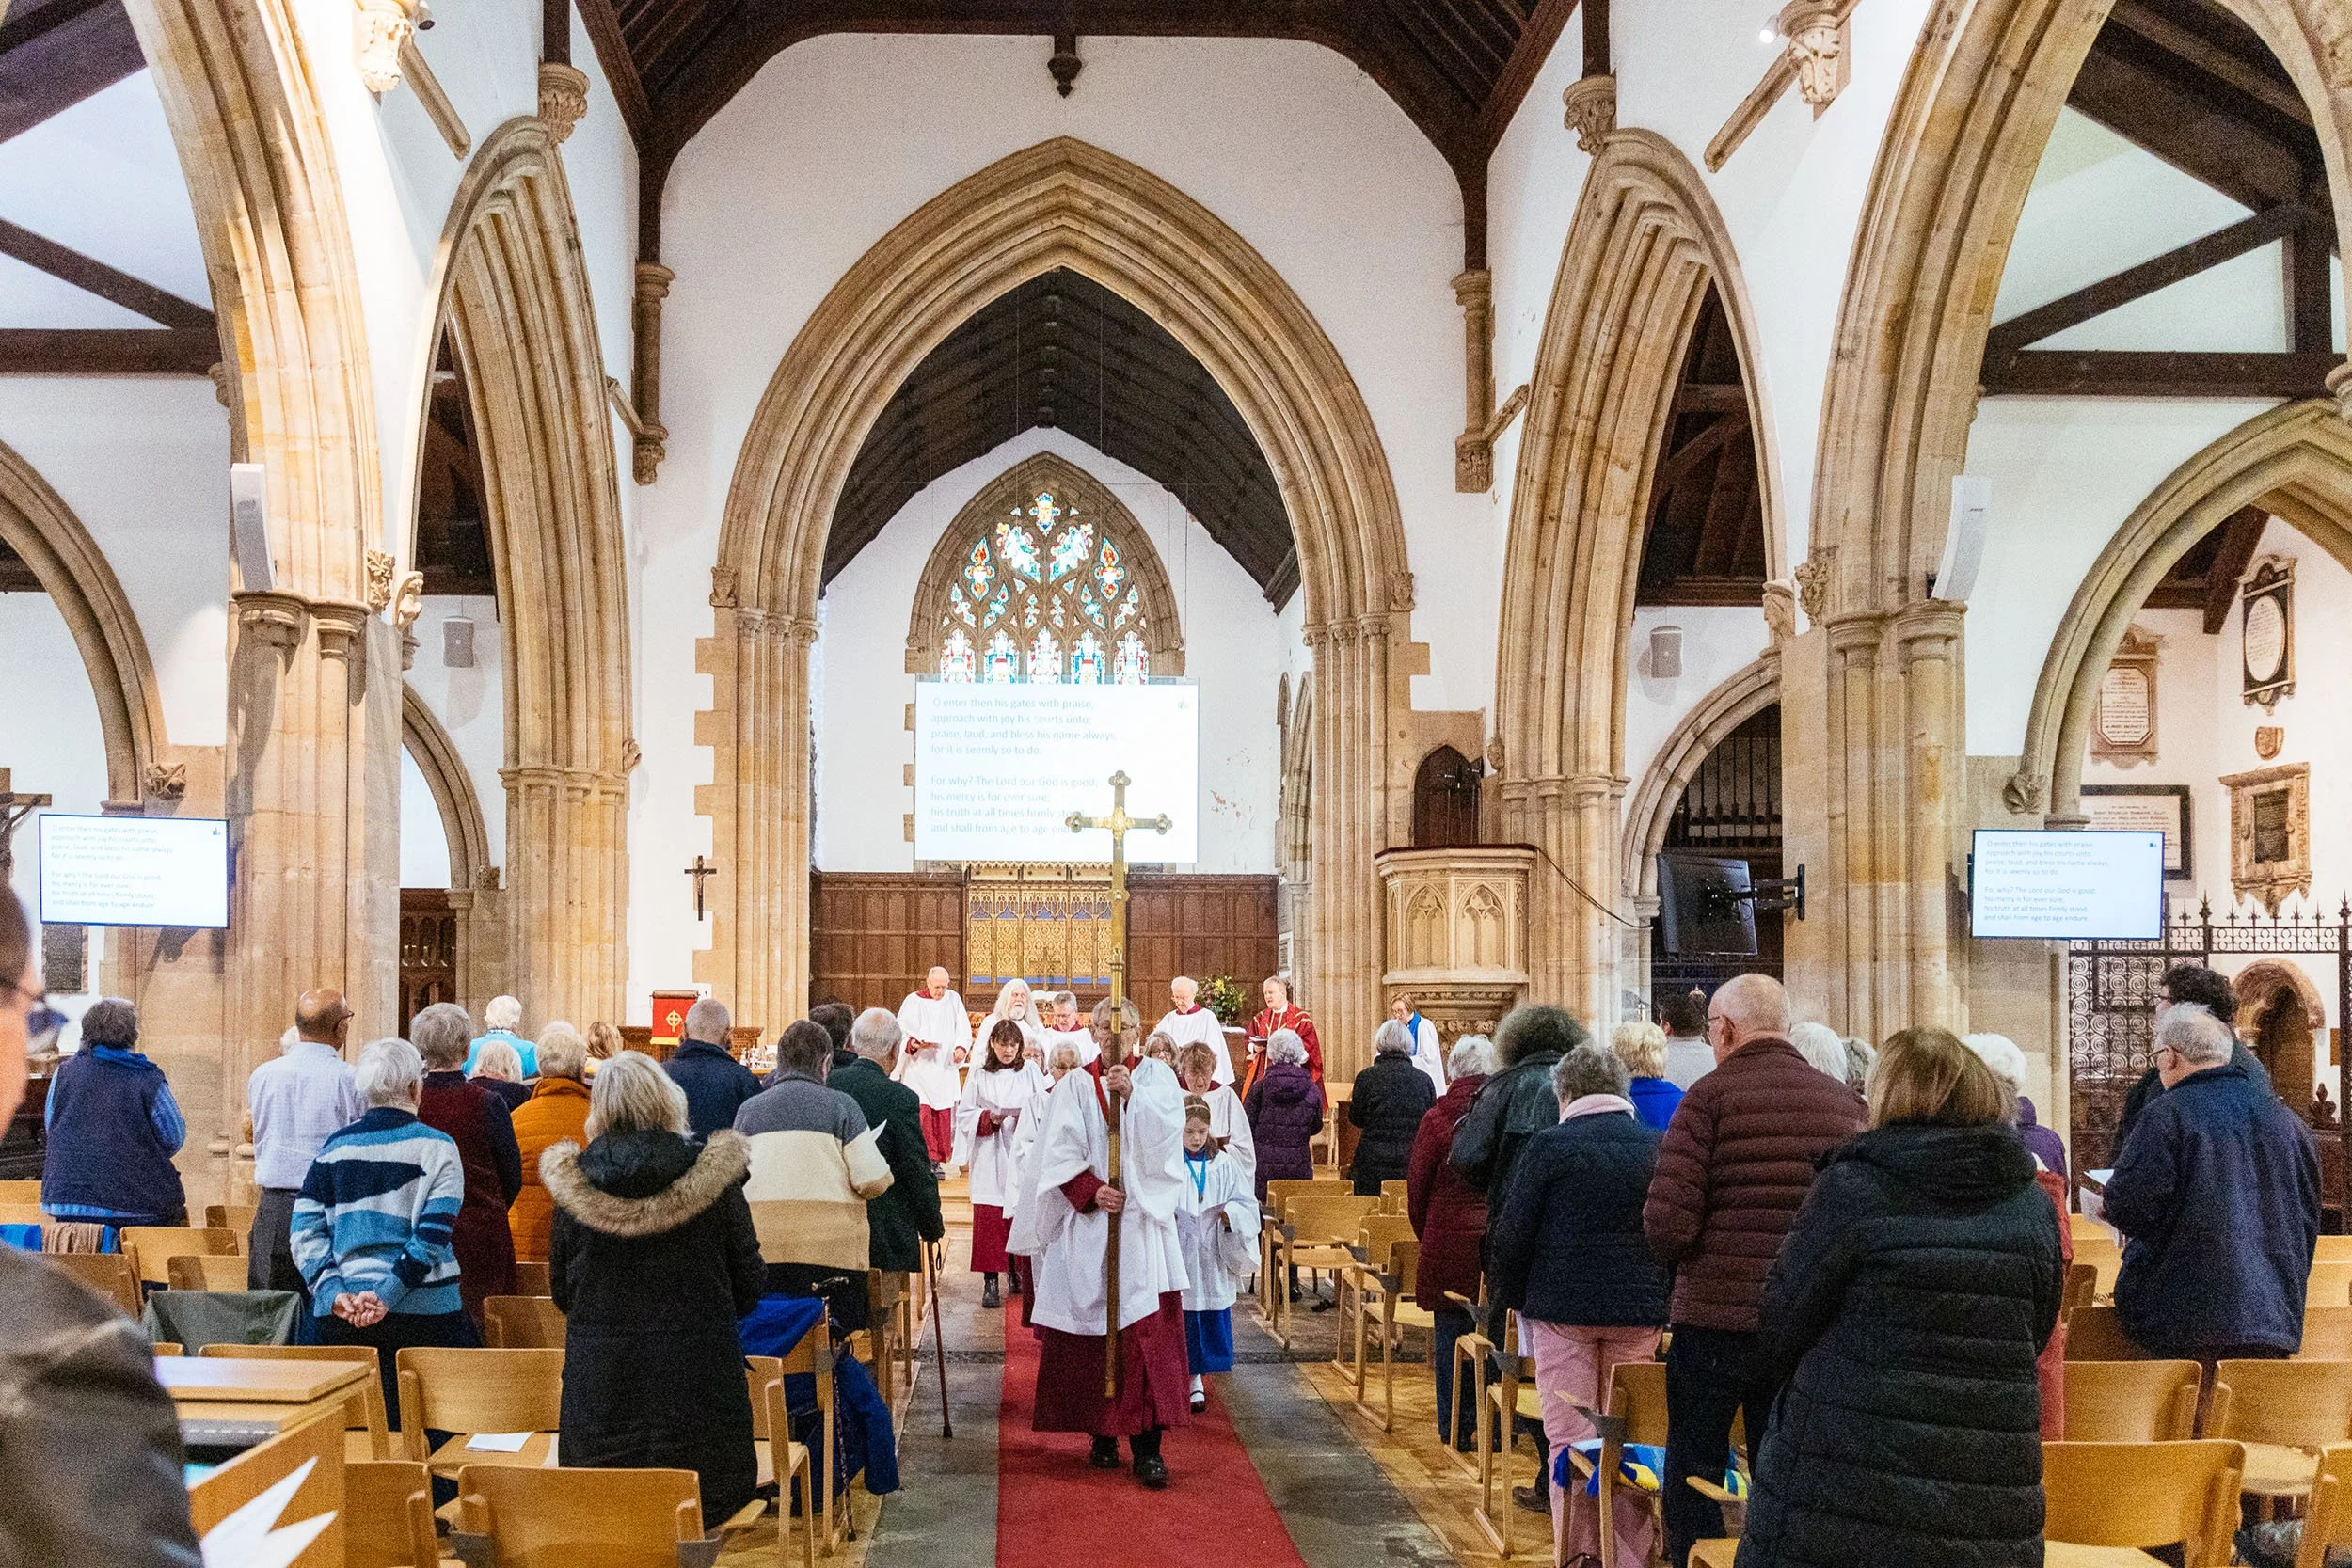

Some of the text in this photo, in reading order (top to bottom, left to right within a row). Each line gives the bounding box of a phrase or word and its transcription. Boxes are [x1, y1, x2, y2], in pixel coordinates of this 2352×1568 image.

[932, 698, 941, 708] O
[943, 698, 967, 708] enter
[970, 698, 993, 708] then
[994, 698, 1009, 708] his
[1009, 698, 1036, 711] gates
[1038, 699, 1059, 708] with
[930, 714, 975, 726] approach
[977, 714, 998, 723] with
[1000, 714, 1015, 726] joy
[1017, 714, 1031, 723] his
[990, 729, 1009, 739] and
[1010, 729, 1035, 739] bless
[1037, 729, 1051, 739] his
[930, 745, 945, 754] for
[946, 745, 953, 754] it
[955, 745, 962, 754] is
[965, 745, 998, 757] seemly
[1014, 745, 1025, 755] to
[930, 775, 946, 785] For
[948, 776, 973, 788] why?
[977, 776, 993, 785] The
[995, 776, 1017, 785] Lord
[1019, 778, 1035, 786] our
[1039, 776, 1058, 786] God
[1060, 776, 1069, 786] is
[930, 791, 945, 801] his
[946, 794, 975, 804] mercy
[977, 791, 986, 801] is
[988, 792, 1001, 801] for
[930, 807, 945, 817] his
[946, 807, 970, 817] truth
[973, 807, 982, 817] at
[984, 807, 995, 817] all
[998, 807, 1024, 817] times
[1026, 807, 1055, 820] firmly
[930, 822, 948, 832] and
[950, 823, 972, 832] shall
[975, 823, 997, 832] from
[1000, 825, 1015, 835] age
[1020, 823, 1029, 832] to
[1032, 825, 1049, 836] age
